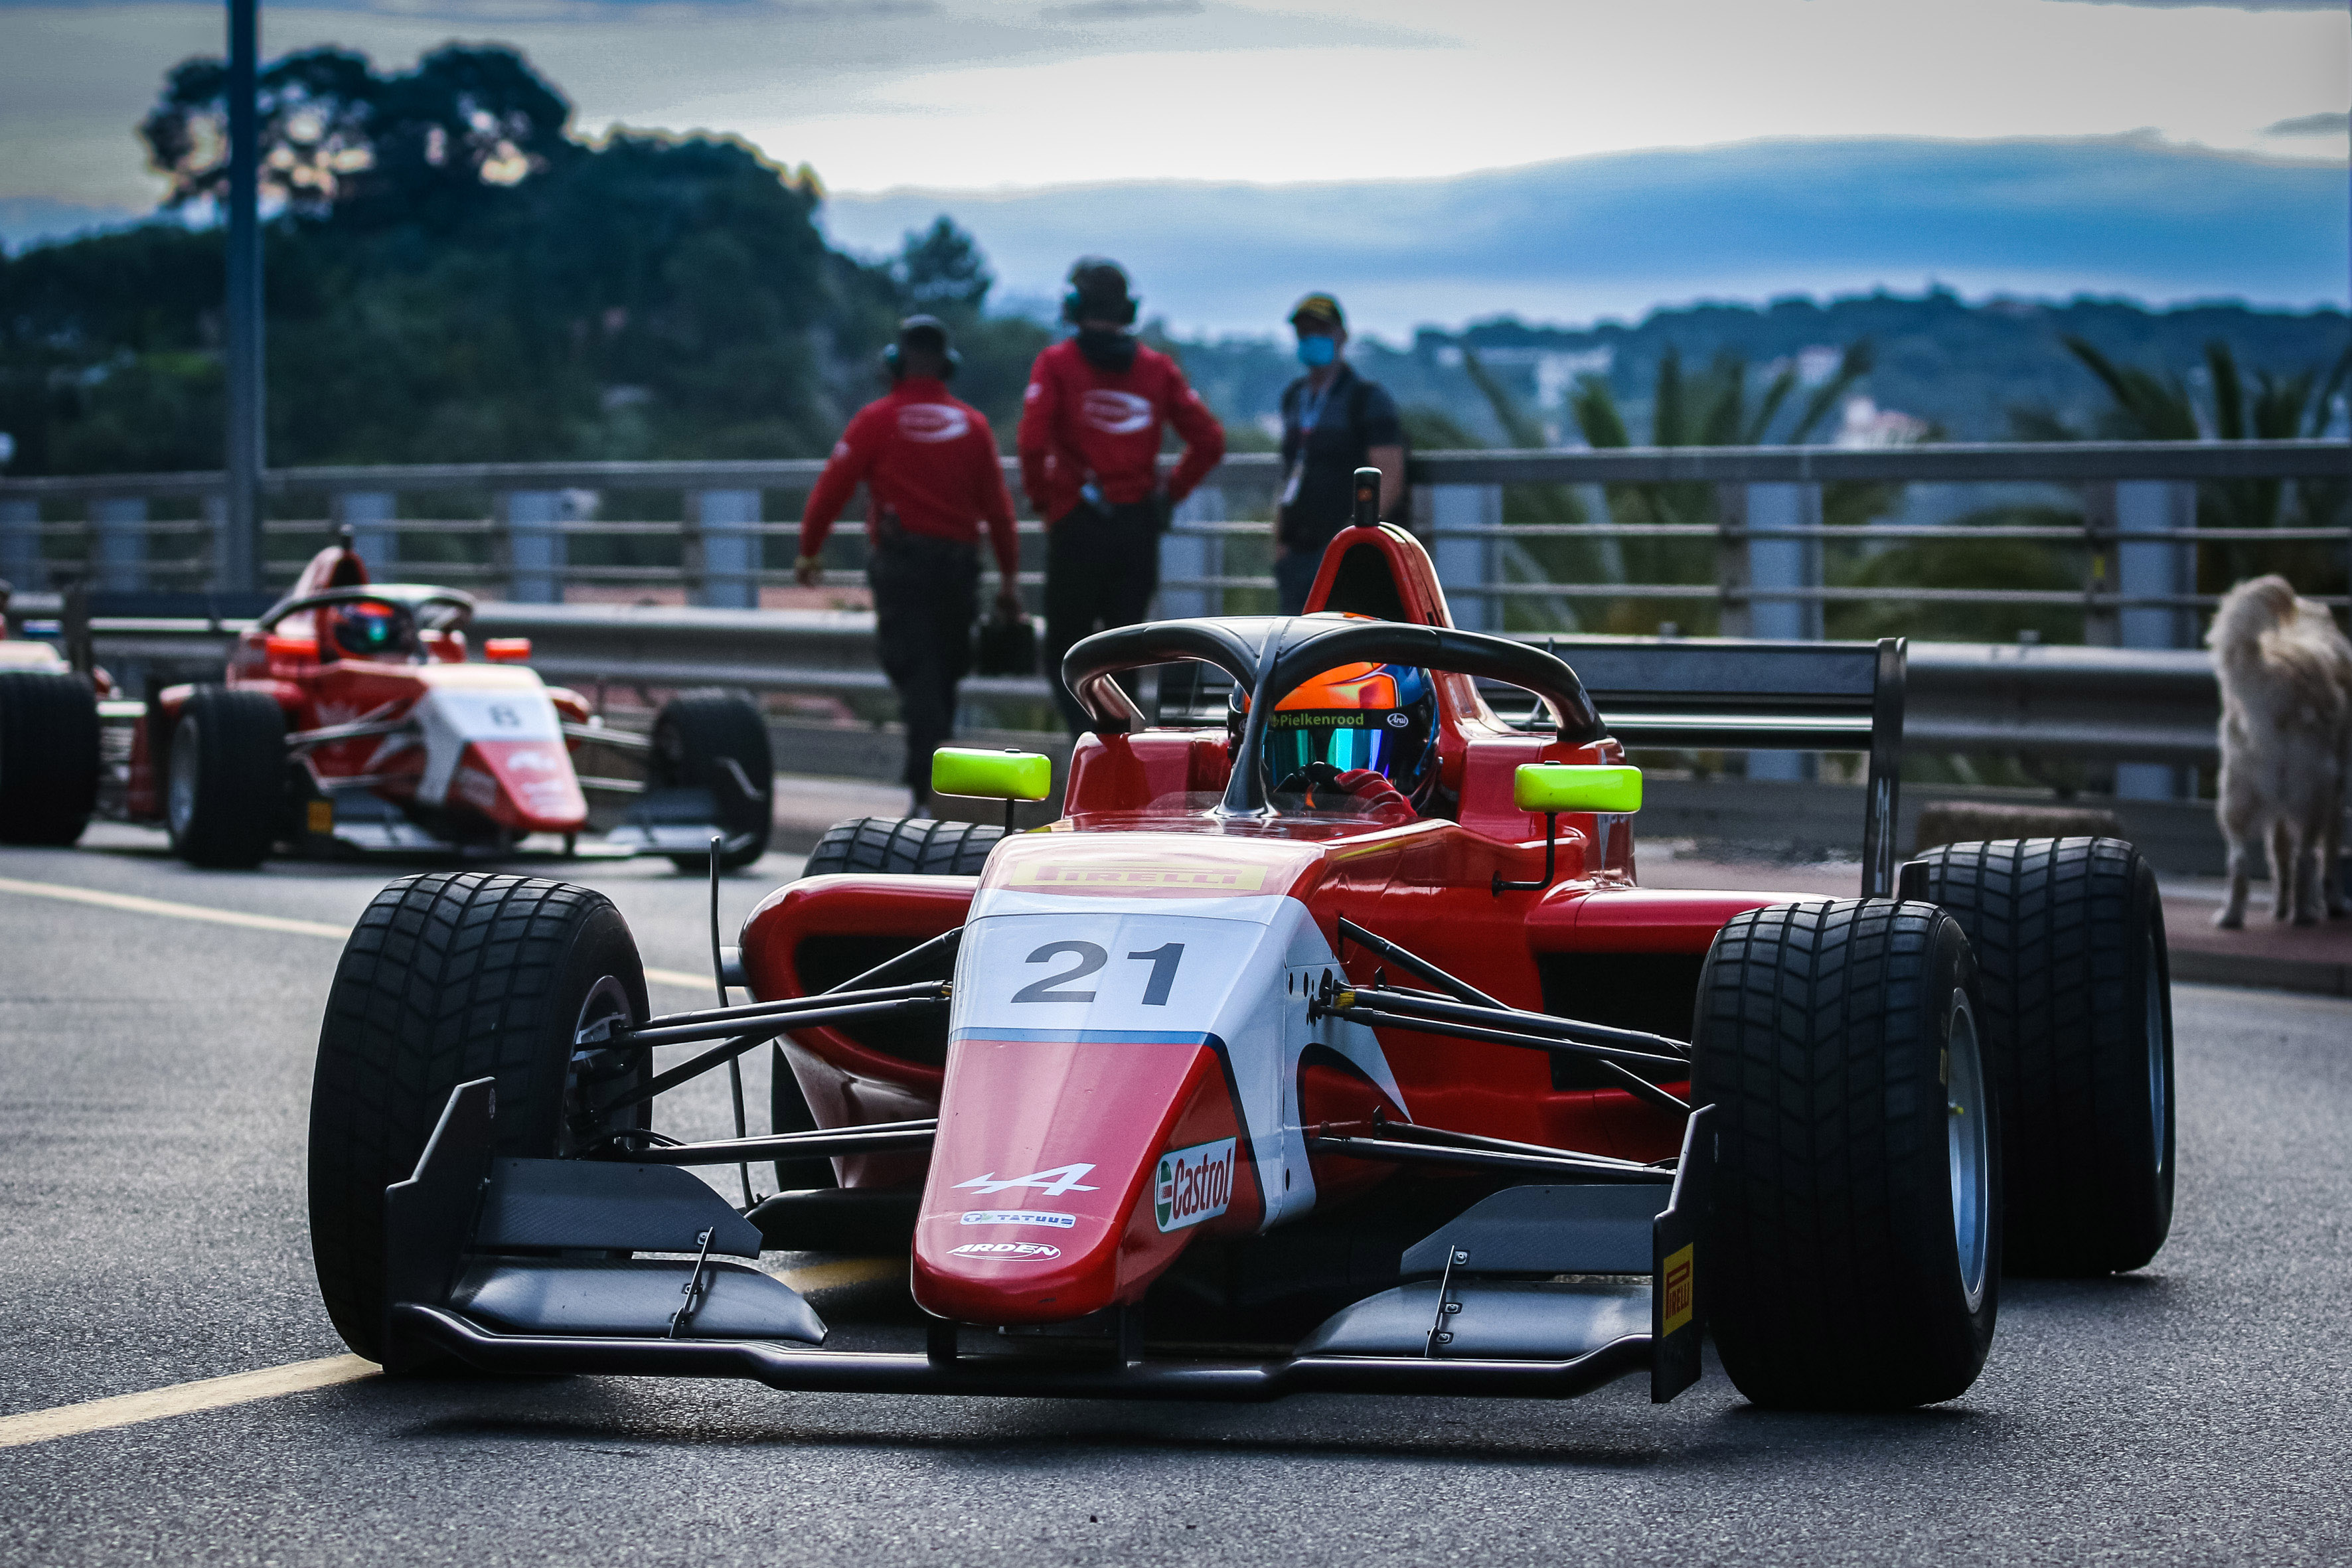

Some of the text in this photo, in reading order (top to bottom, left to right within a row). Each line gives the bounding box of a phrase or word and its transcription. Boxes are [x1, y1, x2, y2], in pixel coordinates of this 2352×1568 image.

[1281, 714, 1364, 726] Pielkenrood
[1389, 714, 1406, 724] Arai
[1034, 865, 1243, 884] PIRELLI
[1010, 941, 1185, 1006] 21
[1173, 1147, 1231, 1219] Castrol
[997, 1215, 1073, 1225] TATUUS
[946, 1243, 1061, 1257] ARDEN
[1666, 1260, 1690, 1320] PIRELLI
